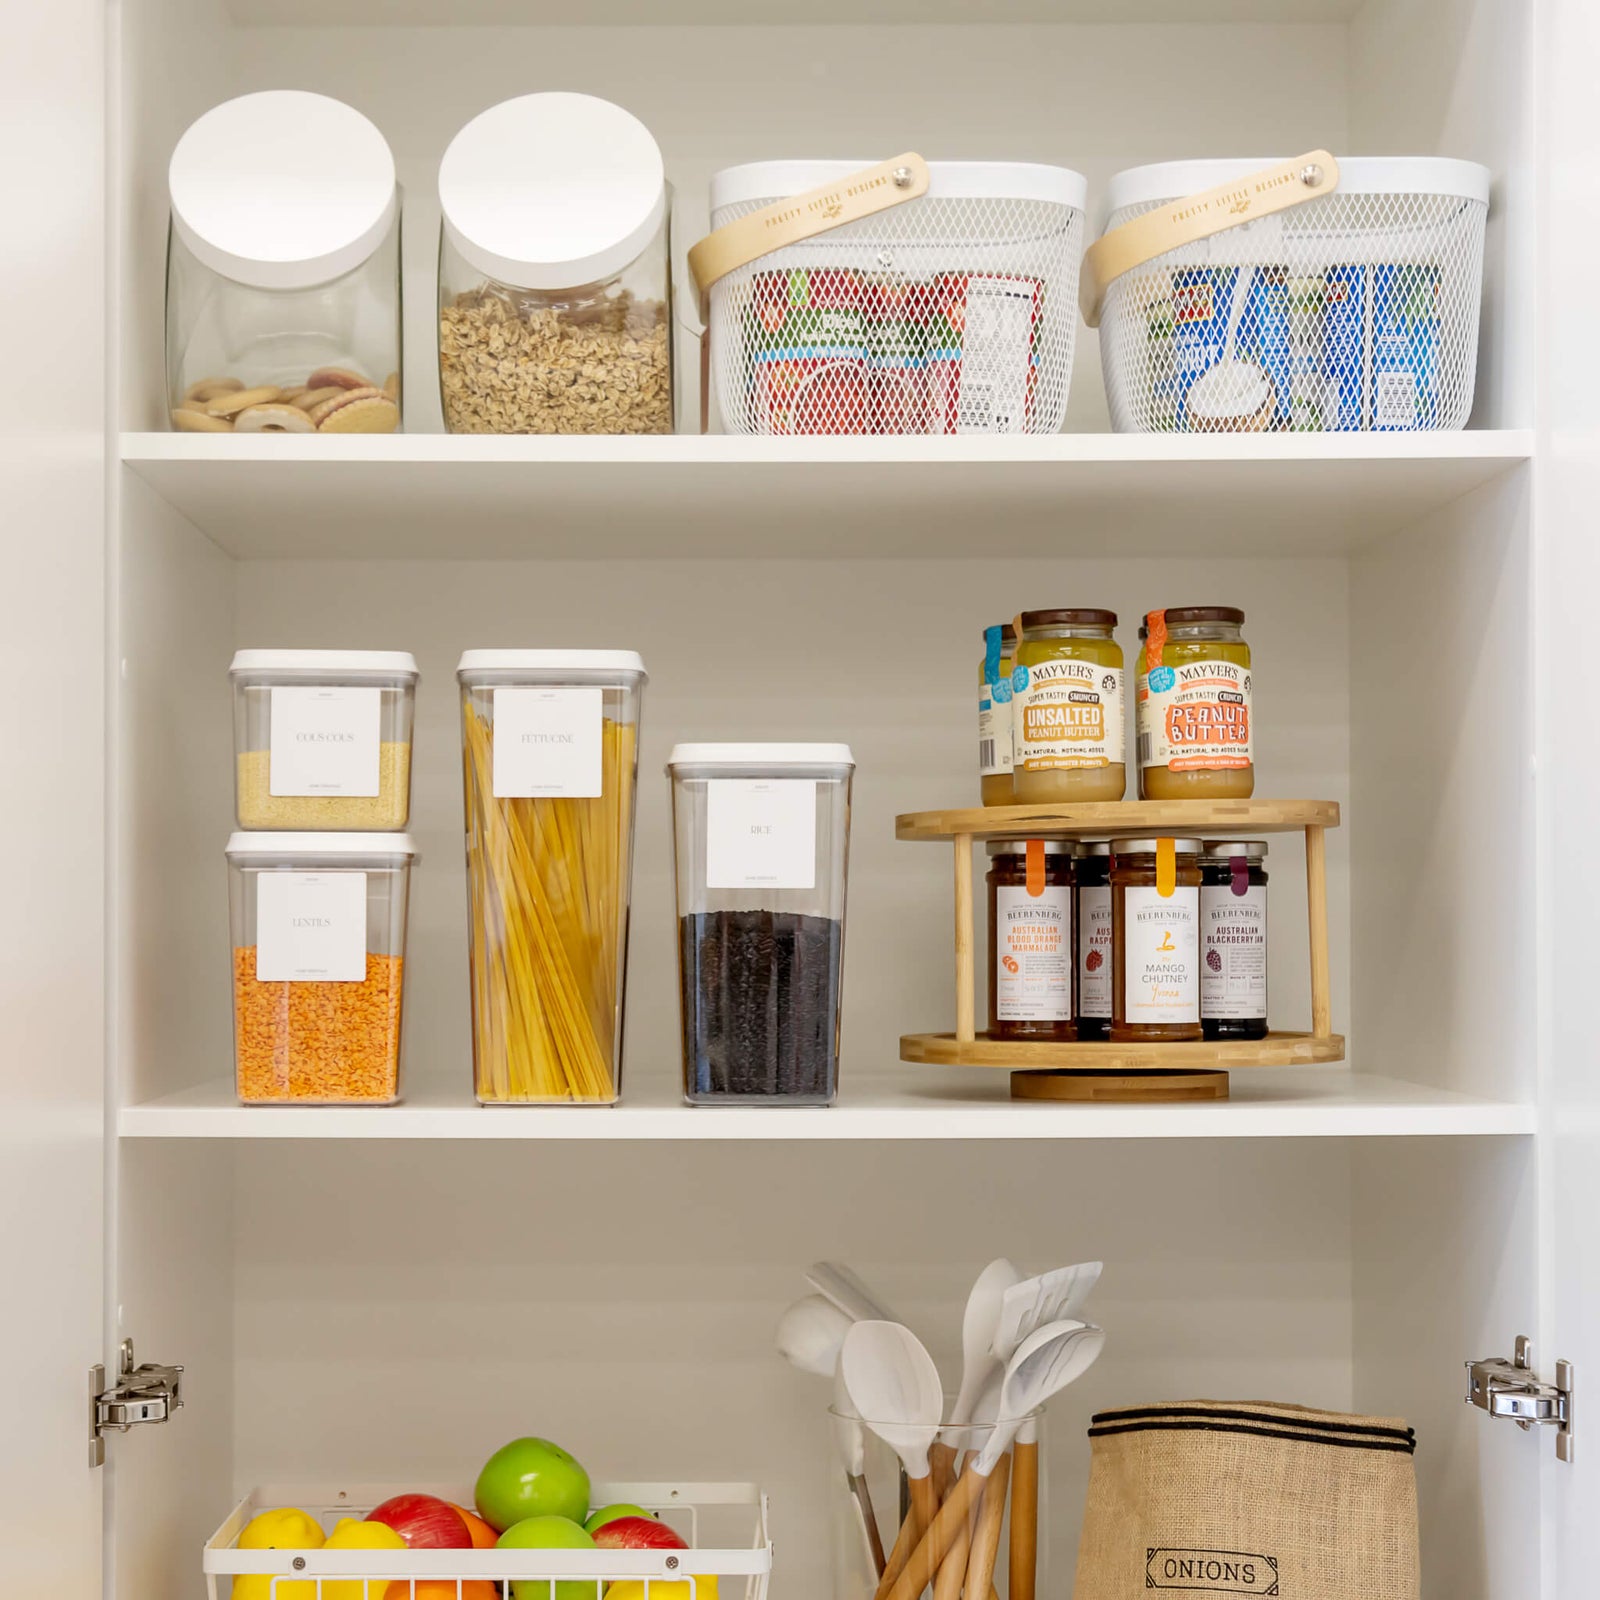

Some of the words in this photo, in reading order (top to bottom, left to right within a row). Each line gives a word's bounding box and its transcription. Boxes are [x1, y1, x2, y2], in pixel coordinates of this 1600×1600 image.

[1033, 664, 1094, 681] MAYVER'S
[1180, 664, 1239, 681] MAYVER'S
[1028, 692, 1045, 704] SUPER
[1174, 692, 1194, 703] SUPER
[1027, 707, 1100, 727] UNSALTED
[1171, 706, 1246, 724] PEANUT
[1028, 727, 1063, 738] PEANUT
[1064, 726, 1101, 737] BUTTER
[1171, 724, 1247, 742] BUTTER
[1007, 910, 1062, 921] BEERENBERG
[1012, 926, 1058, 935] AUSTRALIAN
[1216, 926, 1258, 935] AUSTRALIAN
[1007, 935, 1032, 944] BLOOD
[1034, 935, 1062, 944] ORANGE
[1206, 935, 1254, 944] BLACKBERRY
[1012, 944, 1057, 953] MARMALADE
[1145, 964, 1186, 973] MANGO
[1141, 974, 1189, 983] CHUTNEY
[1164, 1558, 1256, 1584] ONIONS
